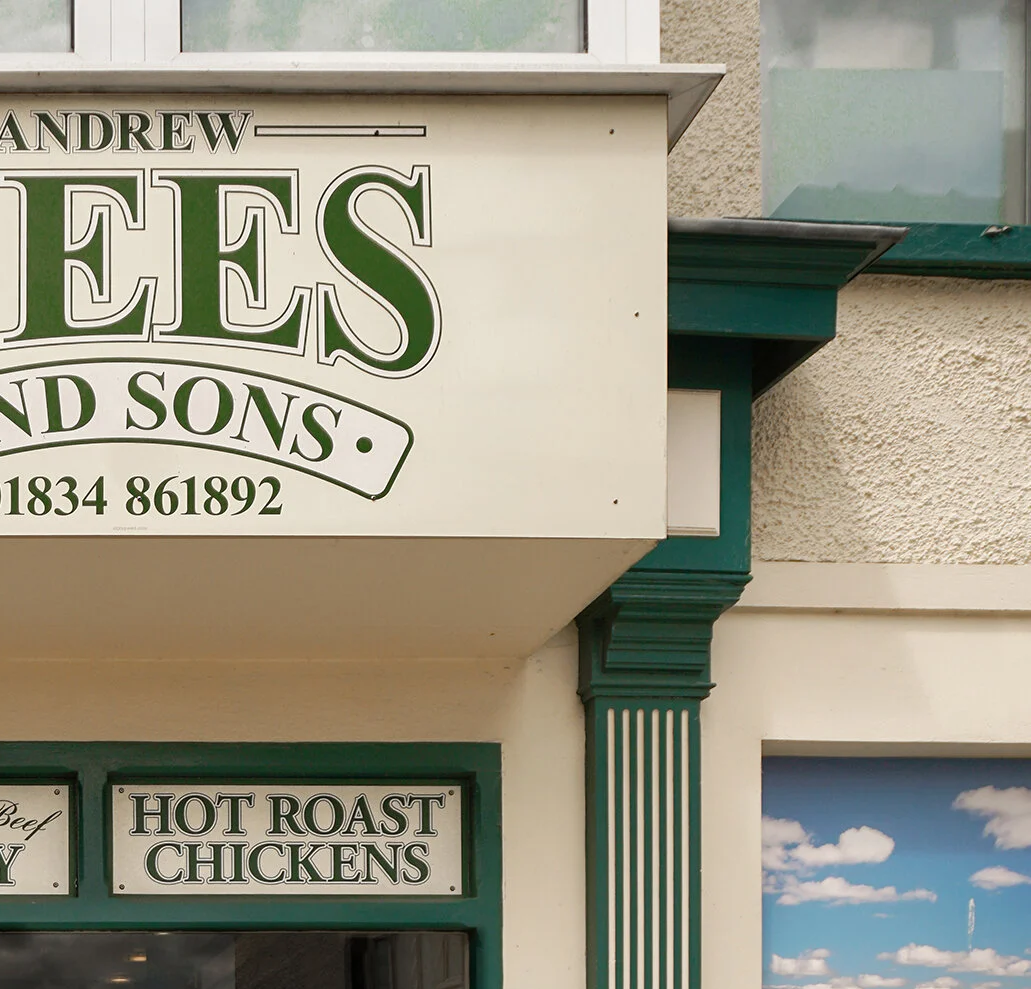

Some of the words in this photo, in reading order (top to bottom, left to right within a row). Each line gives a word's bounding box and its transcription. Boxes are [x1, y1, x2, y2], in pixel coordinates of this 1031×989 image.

[124, 370, 341, 463] SONS
[125, 474, 283, 517] 861892
[128, 791, 256, 839] HOT
[265, 792, 446, 839] ROAST
[143, 840, 431, 887] CHICKENS
